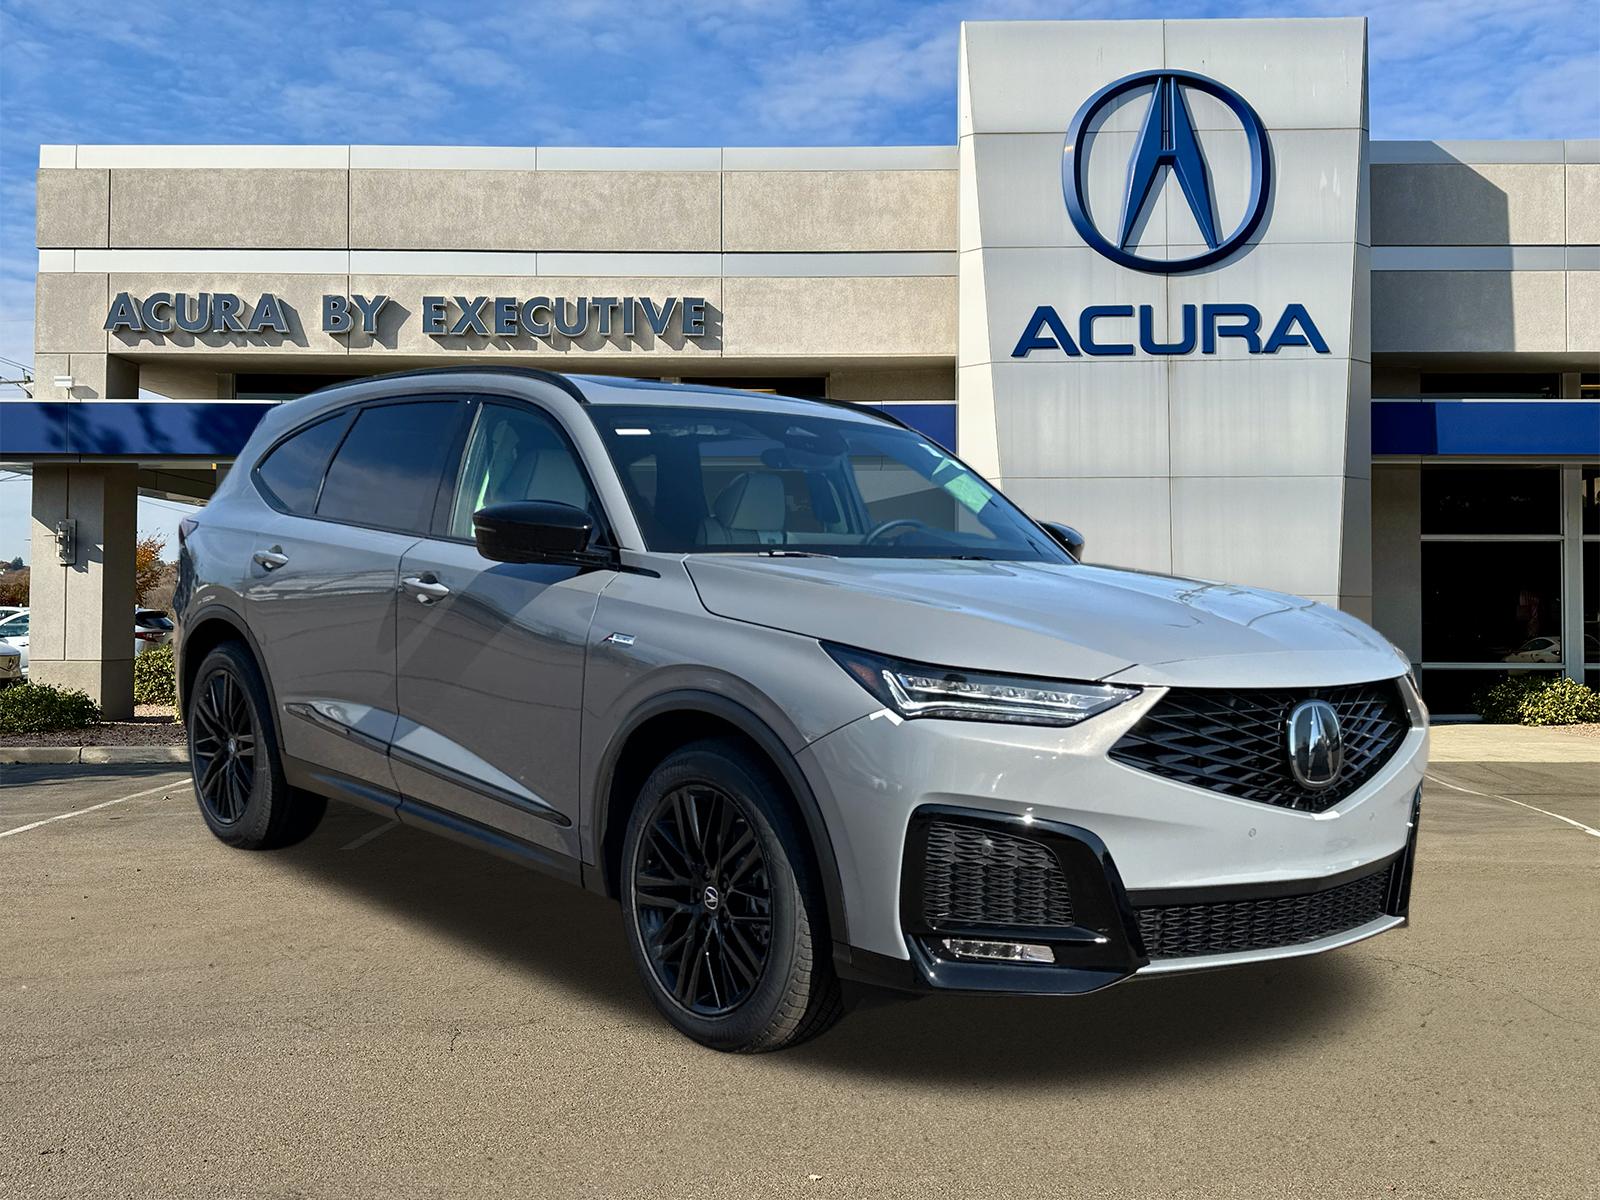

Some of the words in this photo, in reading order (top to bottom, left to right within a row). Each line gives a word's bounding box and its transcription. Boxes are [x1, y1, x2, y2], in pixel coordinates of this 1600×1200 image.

[104, 292, 290, 333] ACURA
[321, 294, 390, 335] BY
[421, 295, 707, 336] EXECUTIVE
[1011, 303, 1331, 356] ACURA
